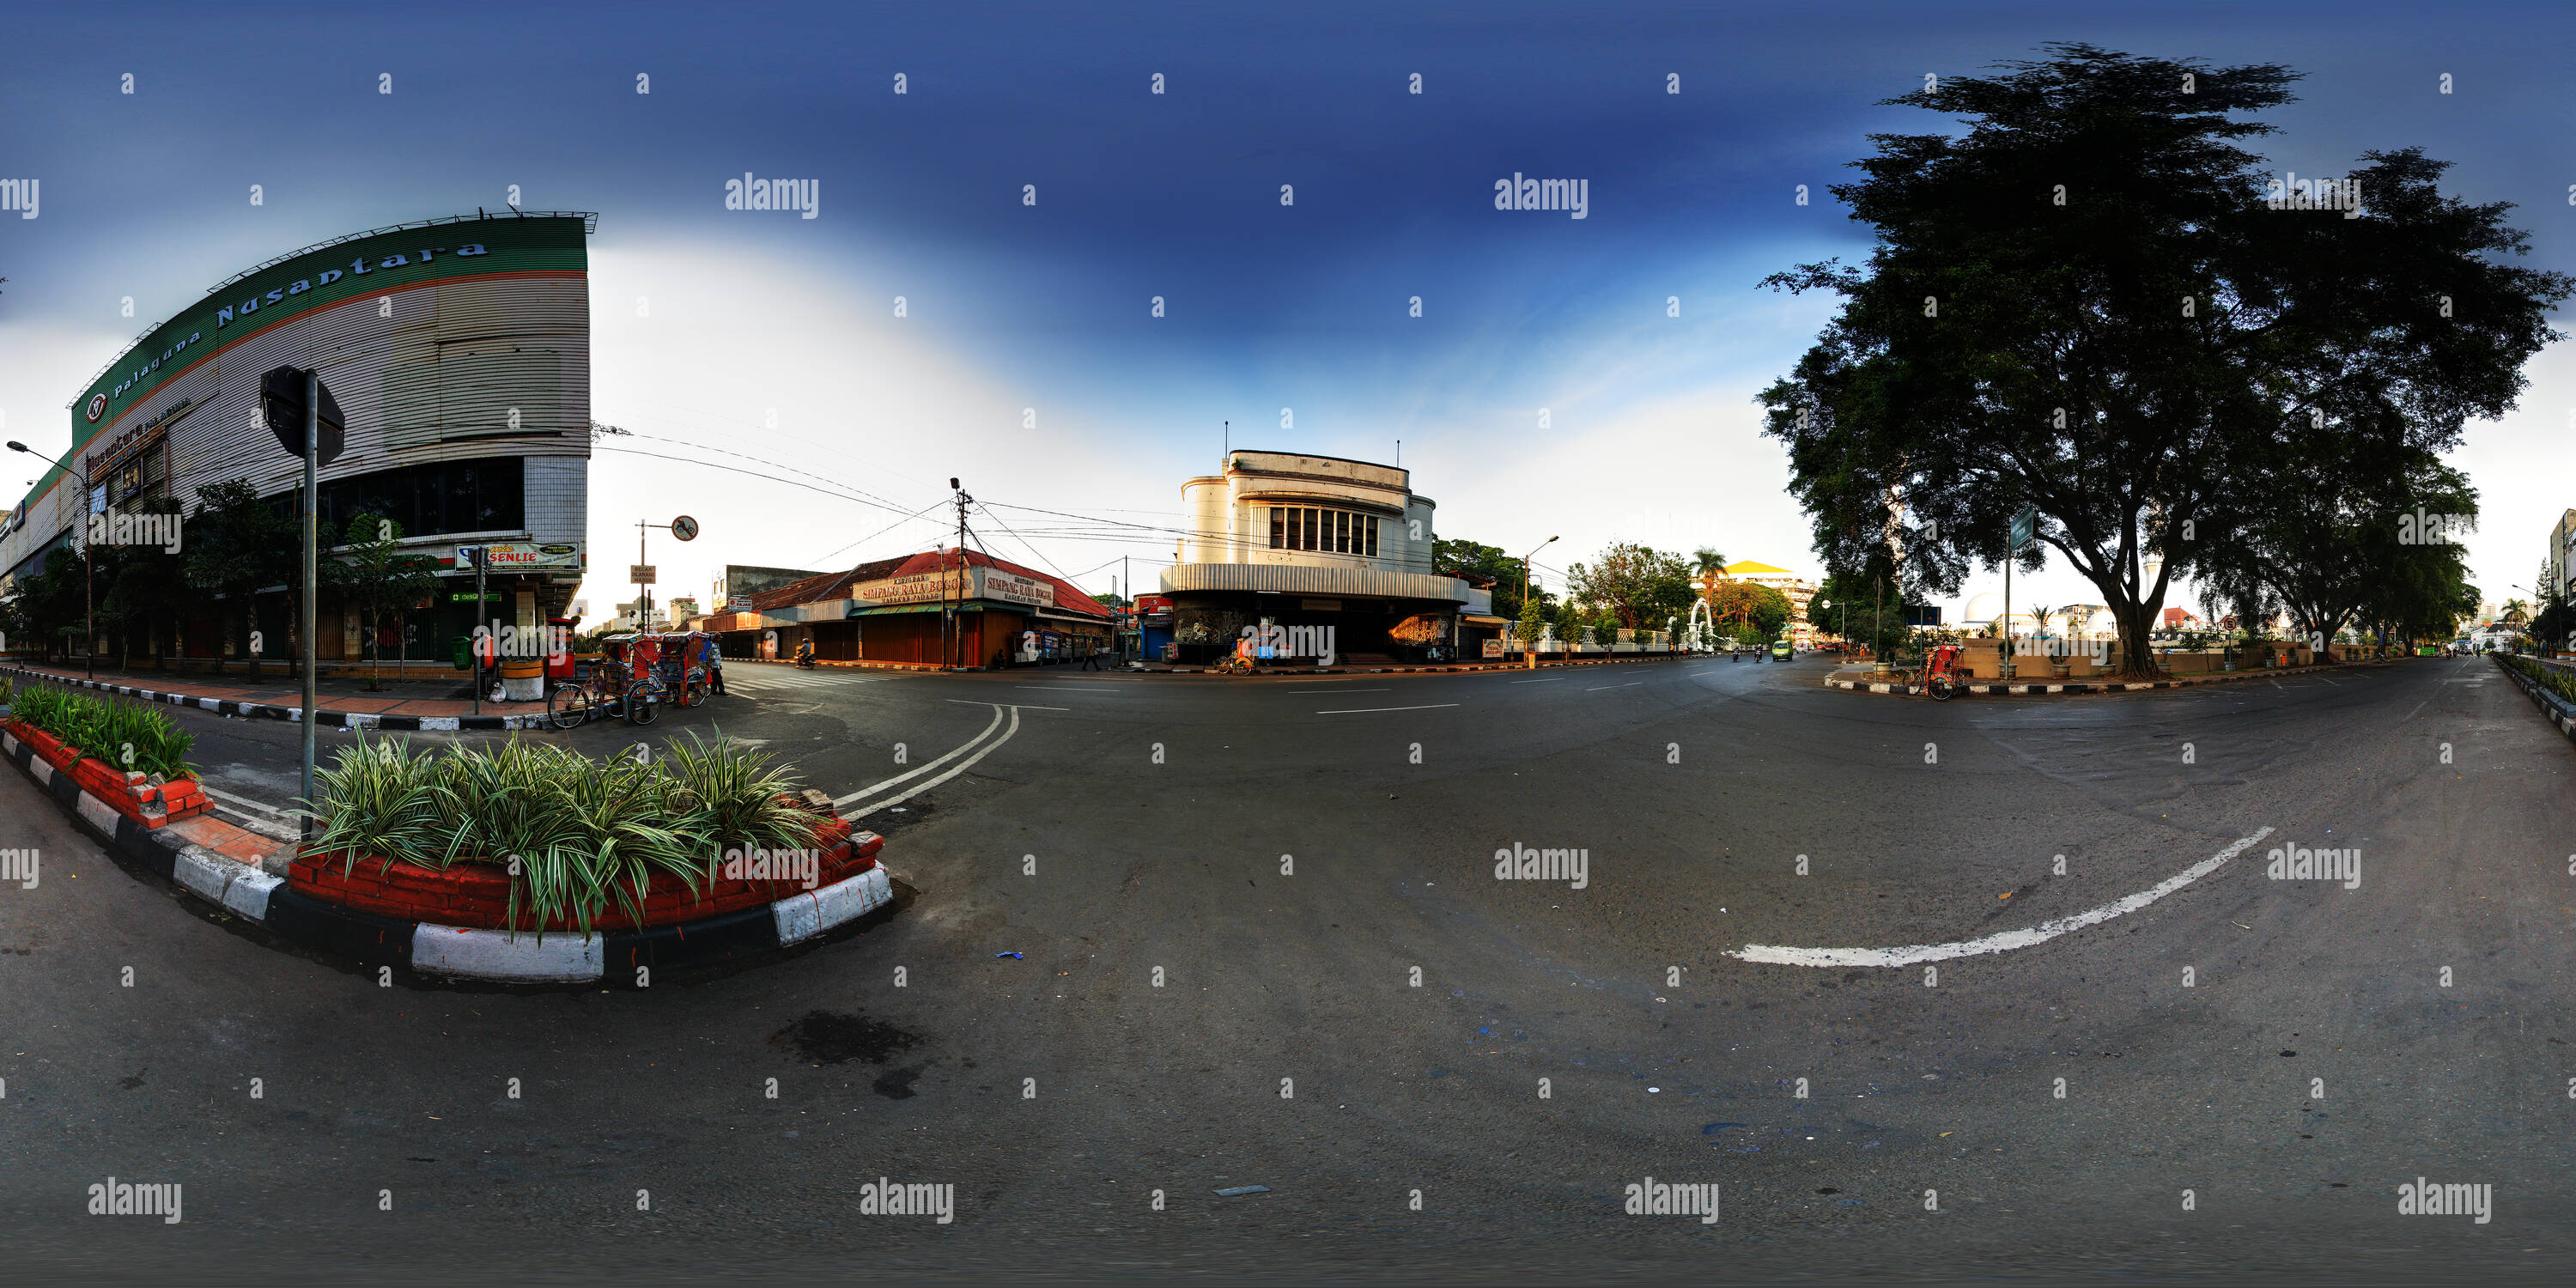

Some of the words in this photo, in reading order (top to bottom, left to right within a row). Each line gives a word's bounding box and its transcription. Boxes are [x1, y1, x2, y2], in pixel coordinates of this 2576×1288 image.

[114, 331, 201, 399] Palaguna
[216, 242, 489, 328] Nusantara
[862, 585, 898, 599] SIMPANG
[901, 582, 927, 596] RAYA
[913, 592, 940, 601] PADANG
[987, 576, 1019, 594] SIMPANG
[1019, 584, 1036, 598] RAYA
[1036, 587, 1052, 601] BOGOR
